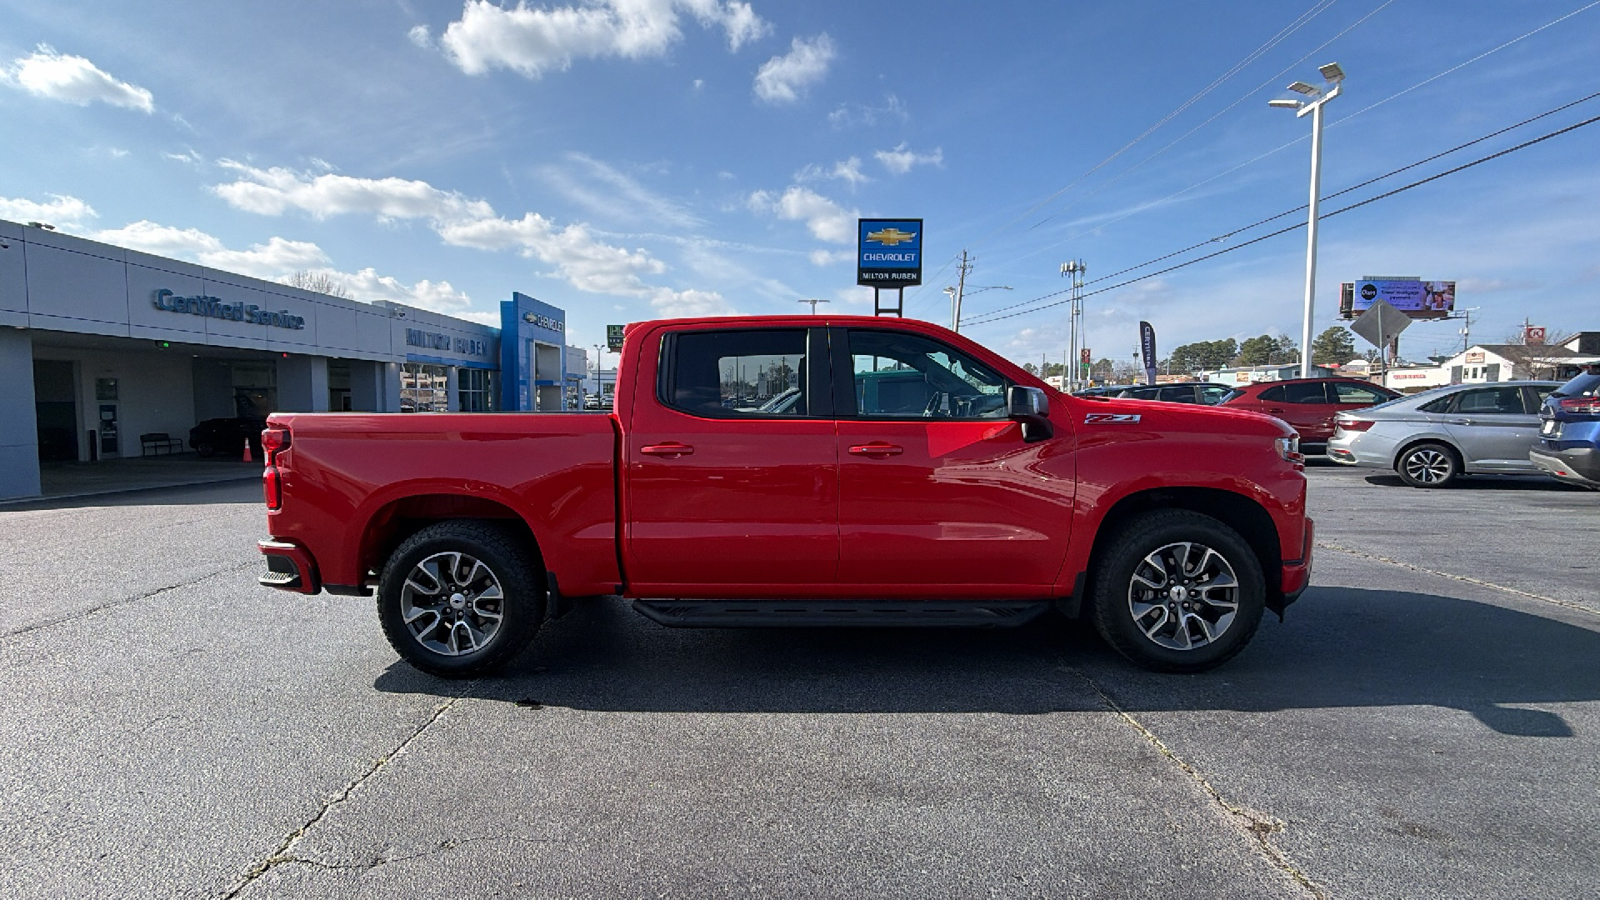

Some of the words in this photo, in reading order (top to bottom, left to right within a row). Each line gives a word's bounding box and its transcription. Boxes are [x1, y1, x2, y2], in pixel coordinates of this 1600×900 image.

[863, 252, 916, 262] CHEVROLET
[862, 272, 889, 280] MILTON
[891, 272, 917, 280] RUBEN
[155, 288, 244, 322] Certified
[245, 304, 305, 331] Service
[537, 314, 564, 333] CHEVROLET
